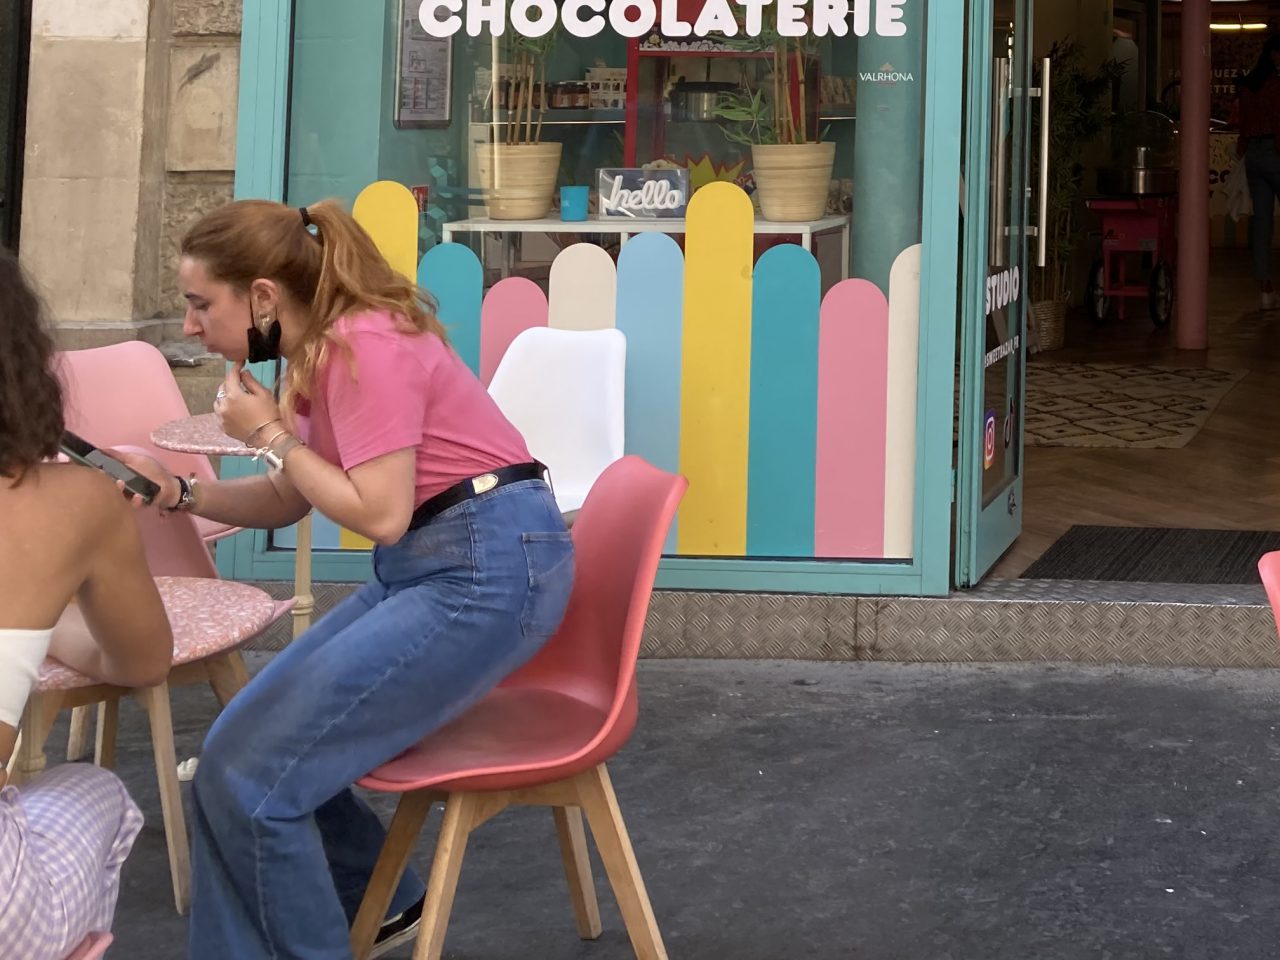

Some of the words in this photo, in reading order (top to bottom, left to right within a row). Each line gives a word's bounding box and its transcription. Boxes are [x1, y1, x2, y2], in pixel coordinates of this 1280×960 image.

[859, 72, 915, 82] VALRHONA
[608, 174, 682, 210] hello
[985, 265, 1020, 315] STUDIO
